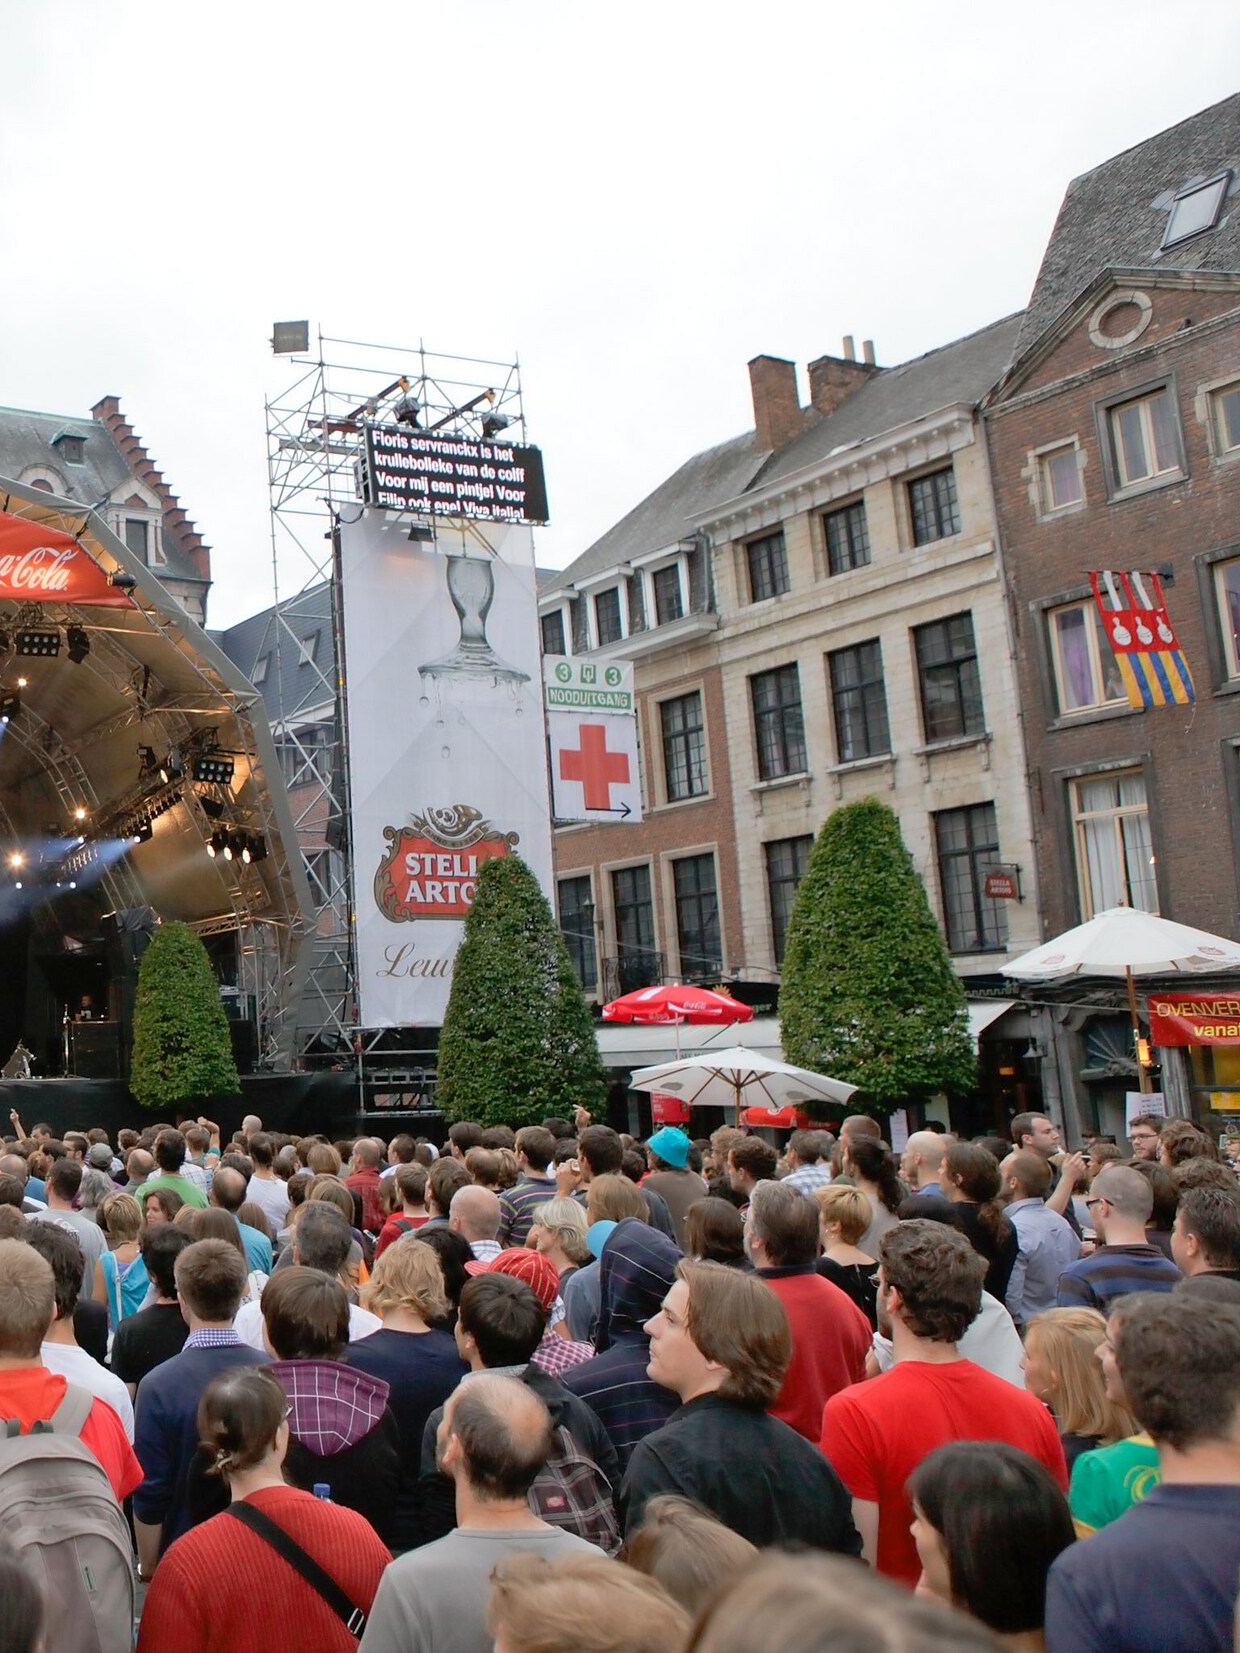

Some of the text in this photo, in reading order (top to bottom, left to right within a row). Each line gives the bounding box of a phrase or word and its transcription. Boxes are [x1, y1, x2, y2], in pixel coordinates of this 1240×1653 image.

[372, 430, 408, 448] Floris
[411, 437, 478, 458] servranckx
[480, 444, 492, 459] is
[494, 445, 514, 462] het
[374, 451, 525, 483] krullebolleke van de colff
[375, 471, 407, 487] Voor
[410, 477, 428, 494] mij
[431, 480, 454, 494] een
[495, 485, 526, 503] Voor
[550, 688, 629, 708] NOODUITGANG
[405, 852, 478, 877] STELL
[405, 879, 478, 905] ARTO
[376, 943, 452, 978] Leuv
